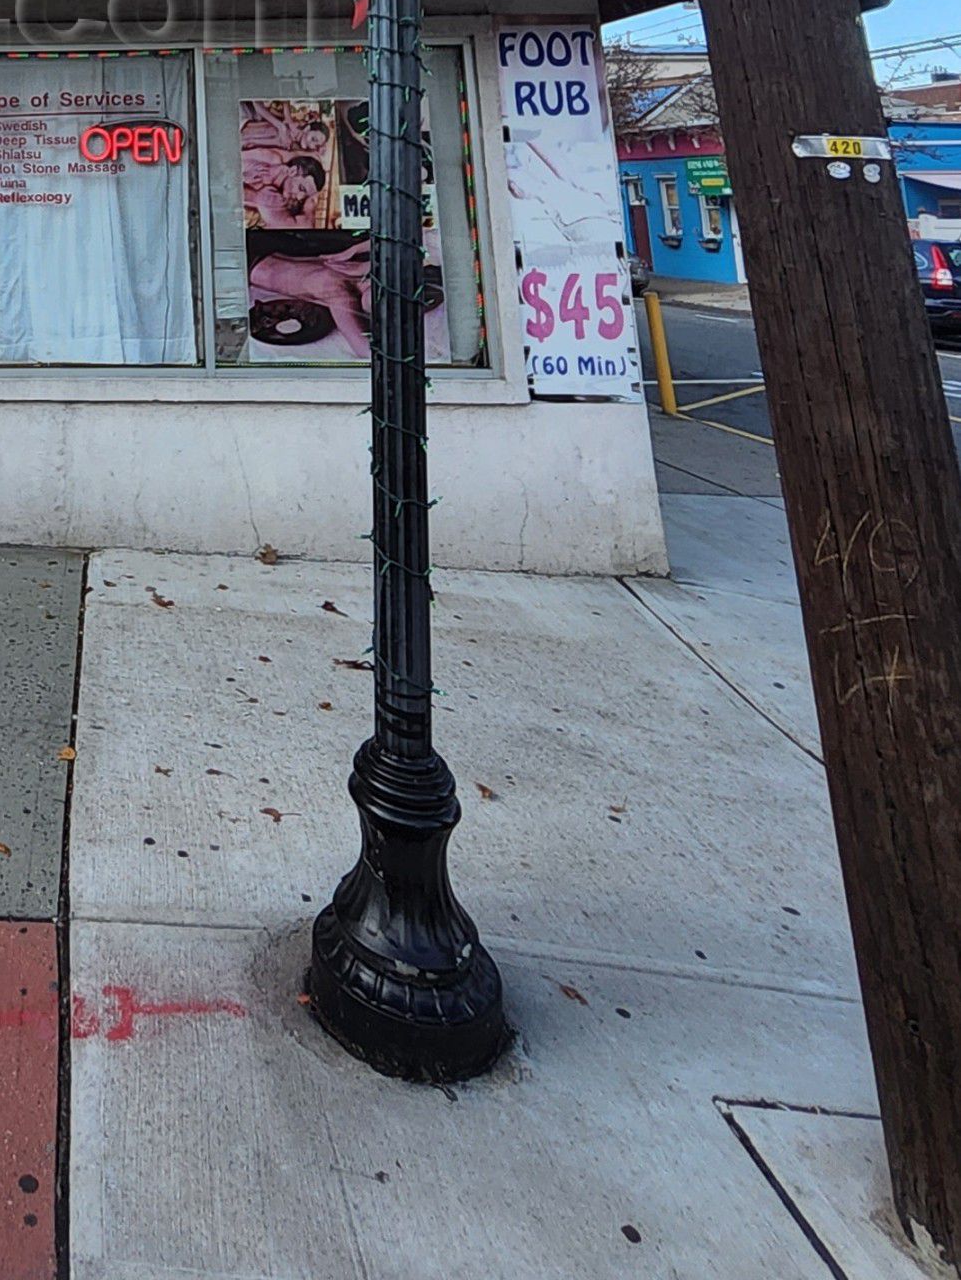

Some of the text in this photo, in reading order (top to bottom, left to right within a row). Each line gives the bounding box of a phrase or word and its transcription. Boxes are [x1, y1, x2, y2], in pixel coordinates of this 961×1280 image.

[499, 30, 595, 68] FOOT
[30, 92, 49, 107] of
[514, 80, 591, 117] RUB
[34, 134, 77, 146] Tissue
[79, 125, 184, 164] OPEN
[829, 141, 862, 155] 420
[22, 163, 61, 174] Stone
[67, 162, 126, 175] Massage
[521, 267, 624, 343] $45
[531, 355, 627, 377] (60 Min)
